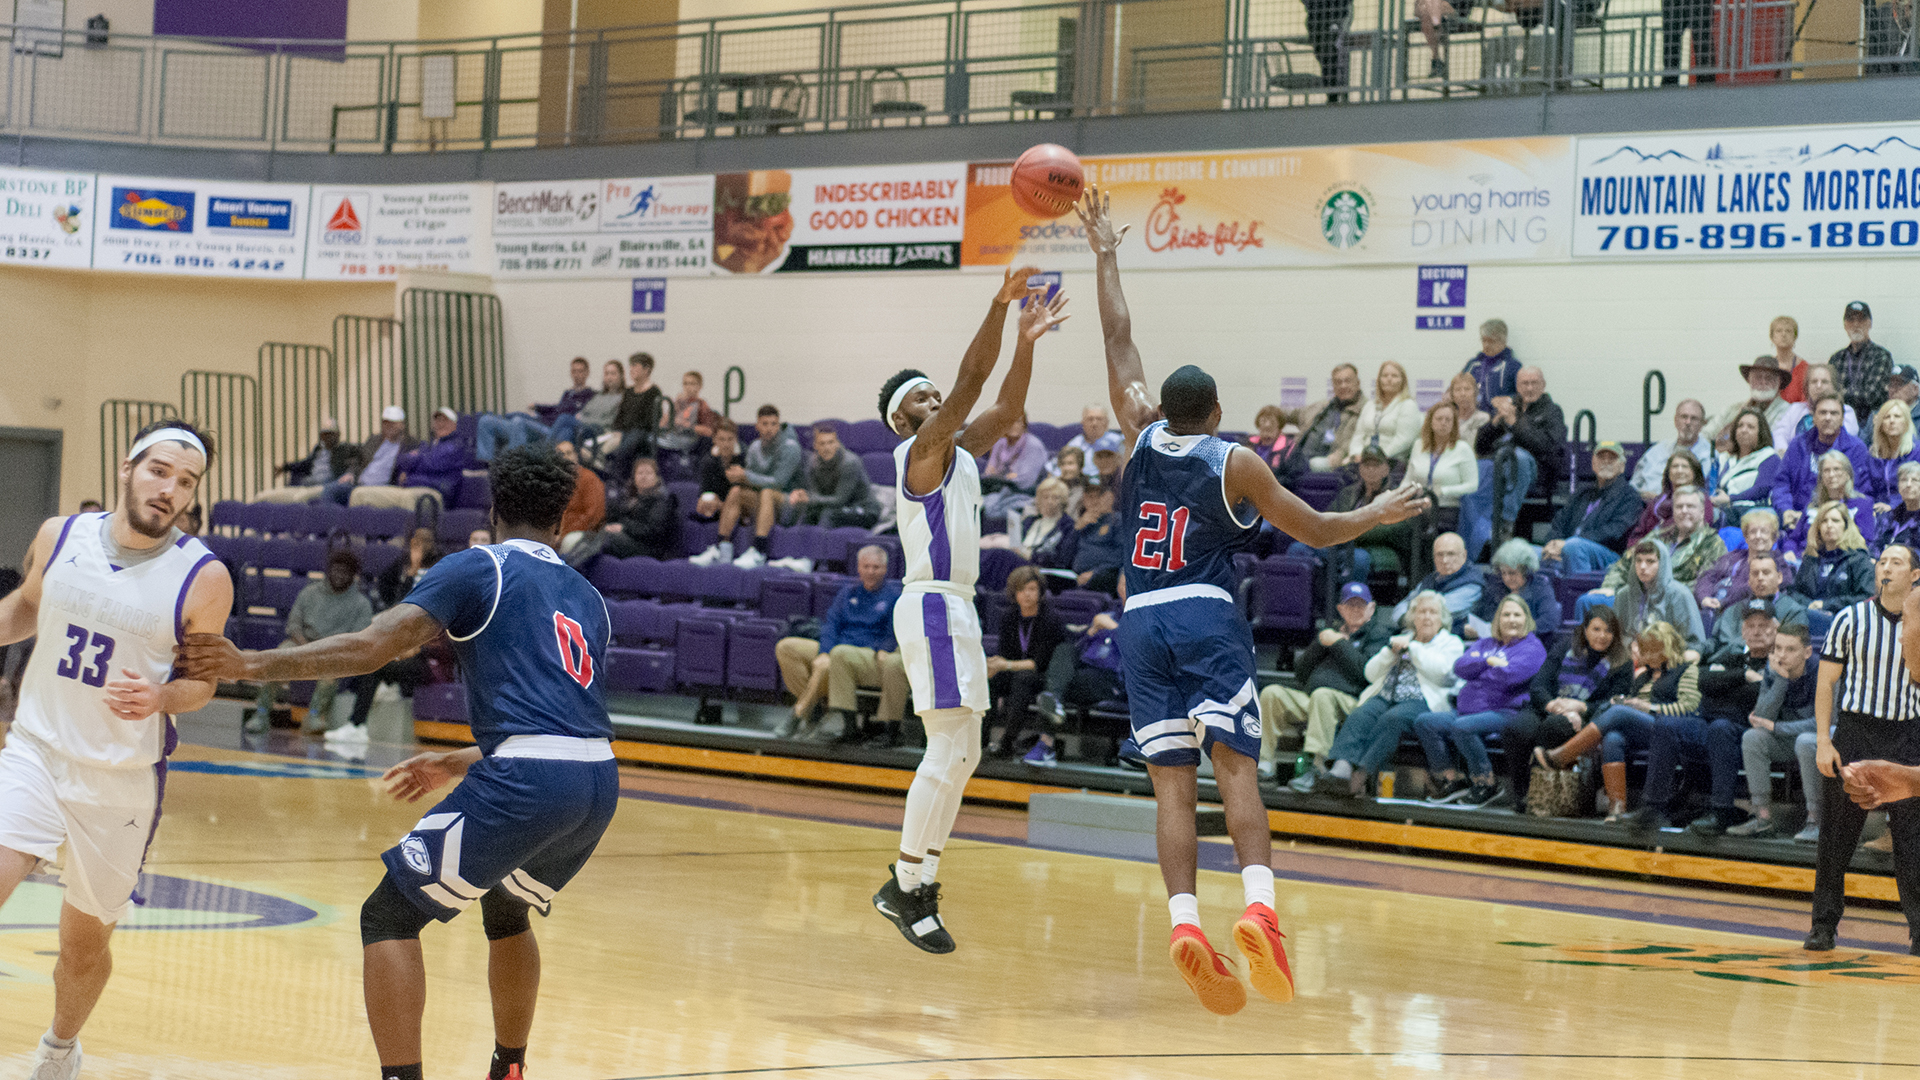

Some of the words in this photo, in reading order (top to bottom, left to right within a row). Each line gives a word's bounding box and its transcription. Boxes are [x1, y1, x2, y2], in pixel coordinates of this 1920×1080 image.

[1102, 162, 1150, 182] CAMPUS
[1154, 160, 1204, 181] CUISINE
[1209, 160, 1217, 179] &
[65, 179, 88, 196] BP
[383, 193, 422, 205] Young
[428, 192, 469, 203] Harris
[606, 182, 631, 203] Pro
[814, 179, 959, 204] INDESCRIBABLY
[1581, 174, 1706, 215] MOUNTAIN
[1717, 172, 1791, 213] LAKES
[1803, 167, 1920, 212] MORTGAG
[213, 200, 243, 214] Ameri
[247, 201, 288, 216] Venture
[498, 188, 574, 214] BenchMark
[1411, 191, 1482, 216] young
[1488, 186, 1550, 209] harris
[497, 217, 534, 228] PHYSICAL
[539, 216, 573, 227] THERAPY
[809, 209, 868, 231] GOOD
[875, 206, 959, 228] CHICKEN
[323, 230, 362, 246] CITGO
[1411, 216, 1548, 247] DINING
[1597, 220, 1919, 250] 706-896-1860
[496, 241, 528, 256] Young
[571, 241, 586, 253] GA
[688, 238, 705, 250] GA
[808, 247, 893, 265] HIAWASSEE
[1420, 268, 1465, 281] SECTION
[1432, 281, 1451, 305] K
[1132, 501, 1190, 572] 21
[96, 597, 161, 640] HARRIS
[57, 623, 116, 688] 33
[553, 610, 594, 690] 0
